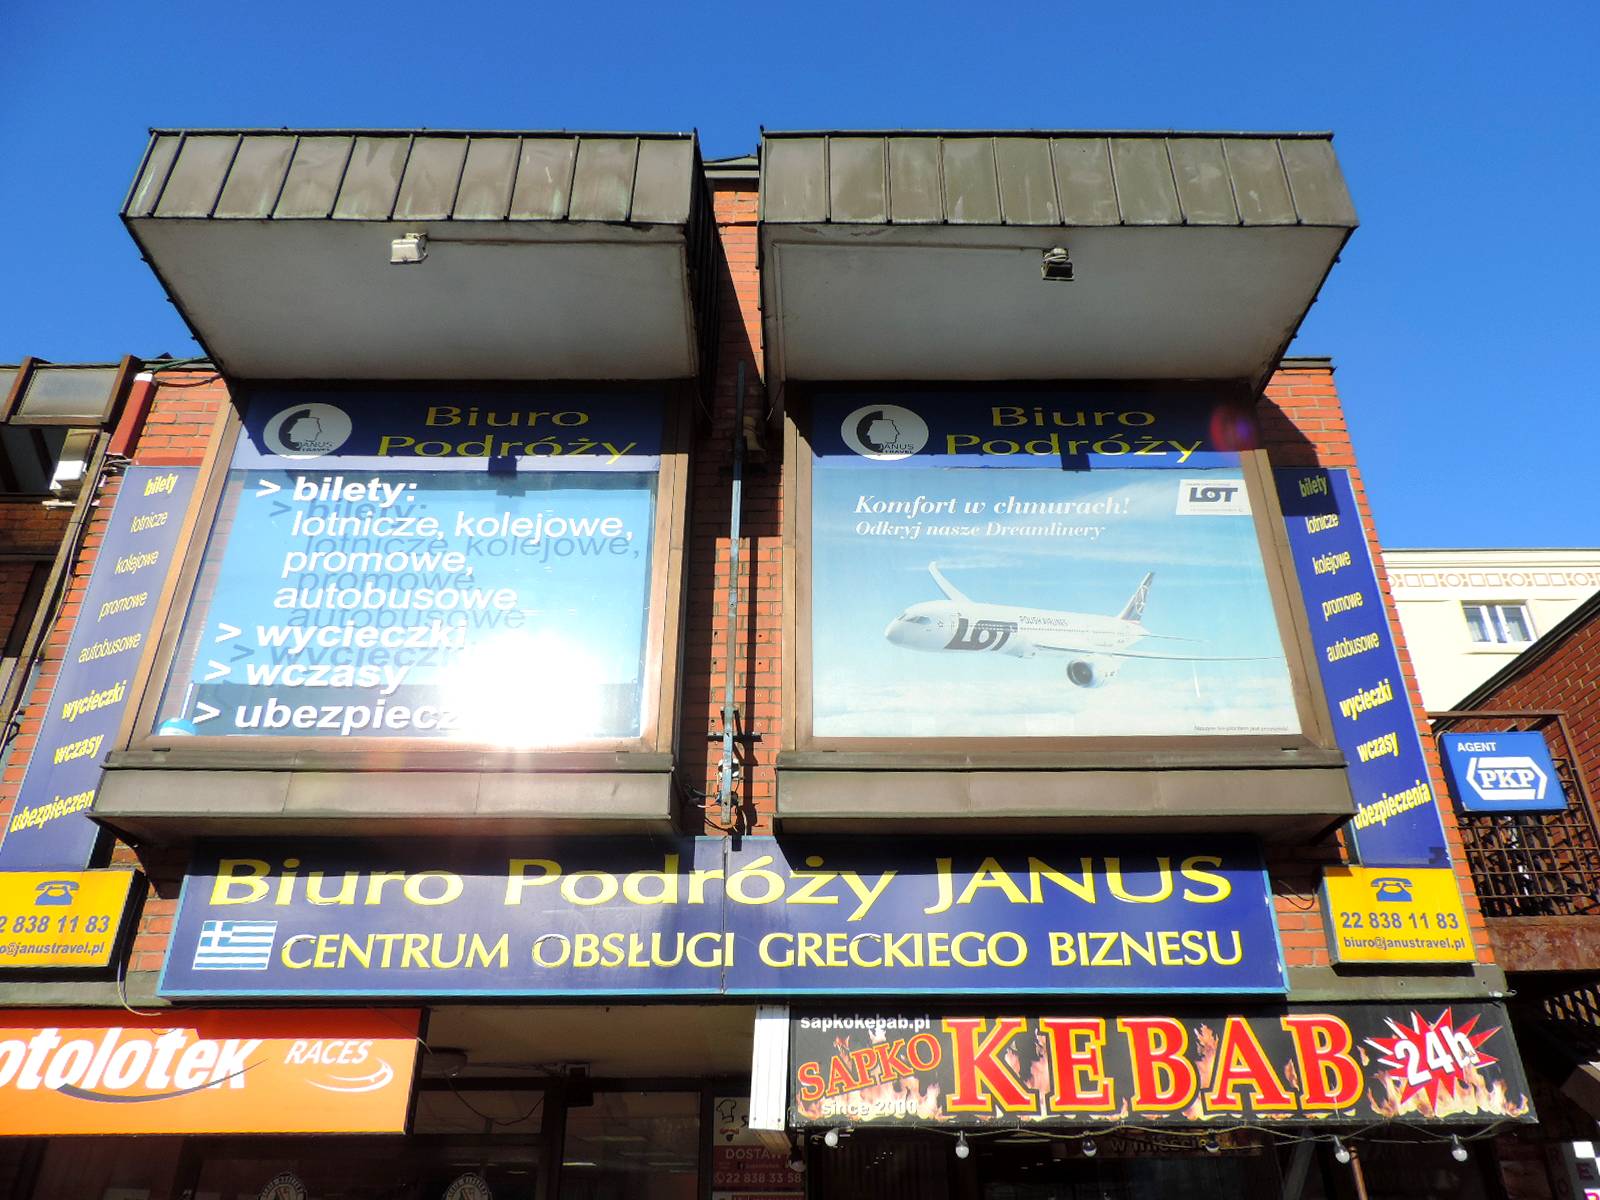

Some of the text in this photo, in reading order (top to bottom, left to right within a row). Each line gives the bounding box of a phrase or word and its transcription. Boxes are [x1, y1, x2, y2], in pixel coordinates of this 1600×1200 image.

[425, 406, 589, 427] Biuro
[991, 406, 1156, 427] Biuro
[377, 434, 637, 465] Podróży
[946, 433, 1203, 463] Podróży
[143, 473, 179, 497] bilety
[292, 477, 418, 507] bilety:
[1189, 487, 1239, 503] LOT
[1298, 475, 1329, 498] bilety
[853, 495, 1131, 519] Komfort w chmurach!
[130, 511, 169, 533] lotnicze
[290, 511, 633, 545] lotnicze, kolejowe,
[855, 521, 1106, 540] Odkryj nasze Dreamlinery
[1304, 513, 1339, 534] lotnicze
[114, 551, 160, 575] kolejowe
[281, 550, 474, 578] promowe,
[1311, 551, 1352, 576] kolejowe
[97, 592, 148, 623] promowe
[273, 583, 518, 610] autobusowe
[1321, 591, 1364, 622] promowe
[78, 632, 142, 664] autobusowe
[256, 619, 467, 654] wycieczki
[943, 617, 1019, 650] LOT
[1326, 632, 1380, 664] autobusowe
[246, 662, 410, 695] wczasy
[61, 679, 127, 722] wycieczki
[1339, 678, 1393, 720] wycieczki
[53, 734, 104, 765] wczasy
[1357, 731, 1399, 763] wczasy
[1457, 742, 1496, 752] AGENT
[1477, 769, 1535, 788] PKP
[1353, 779, 1432, 830] ubezpieczenia
[208, 853, 1232, 921] Biuro Podróży JANUS
[12, 915, 51, 934] 838
[57, 915, 79, 934] 11
[84, 915, 111, 934] 83
[1340, 911, 1459, 930] 22 838 11 83
[280, 930, 1243, 970] CENTRUM OBSŁUGI GRECKIEGO BIZNESU
[1344, 937, 1466, 950] biuro@janustravel.pl
[799, 1013, 931, 1032] sapkokebab.pl
[284, 1040, 374, 1065] RACES
[797, 1032, 942, 1101] SAPKO
[941, 1014, 1365, 1113] KEBAB
[1393, 1024, 1480, 1087] 24h
[820, 1100, 919, 1117] since 2000
